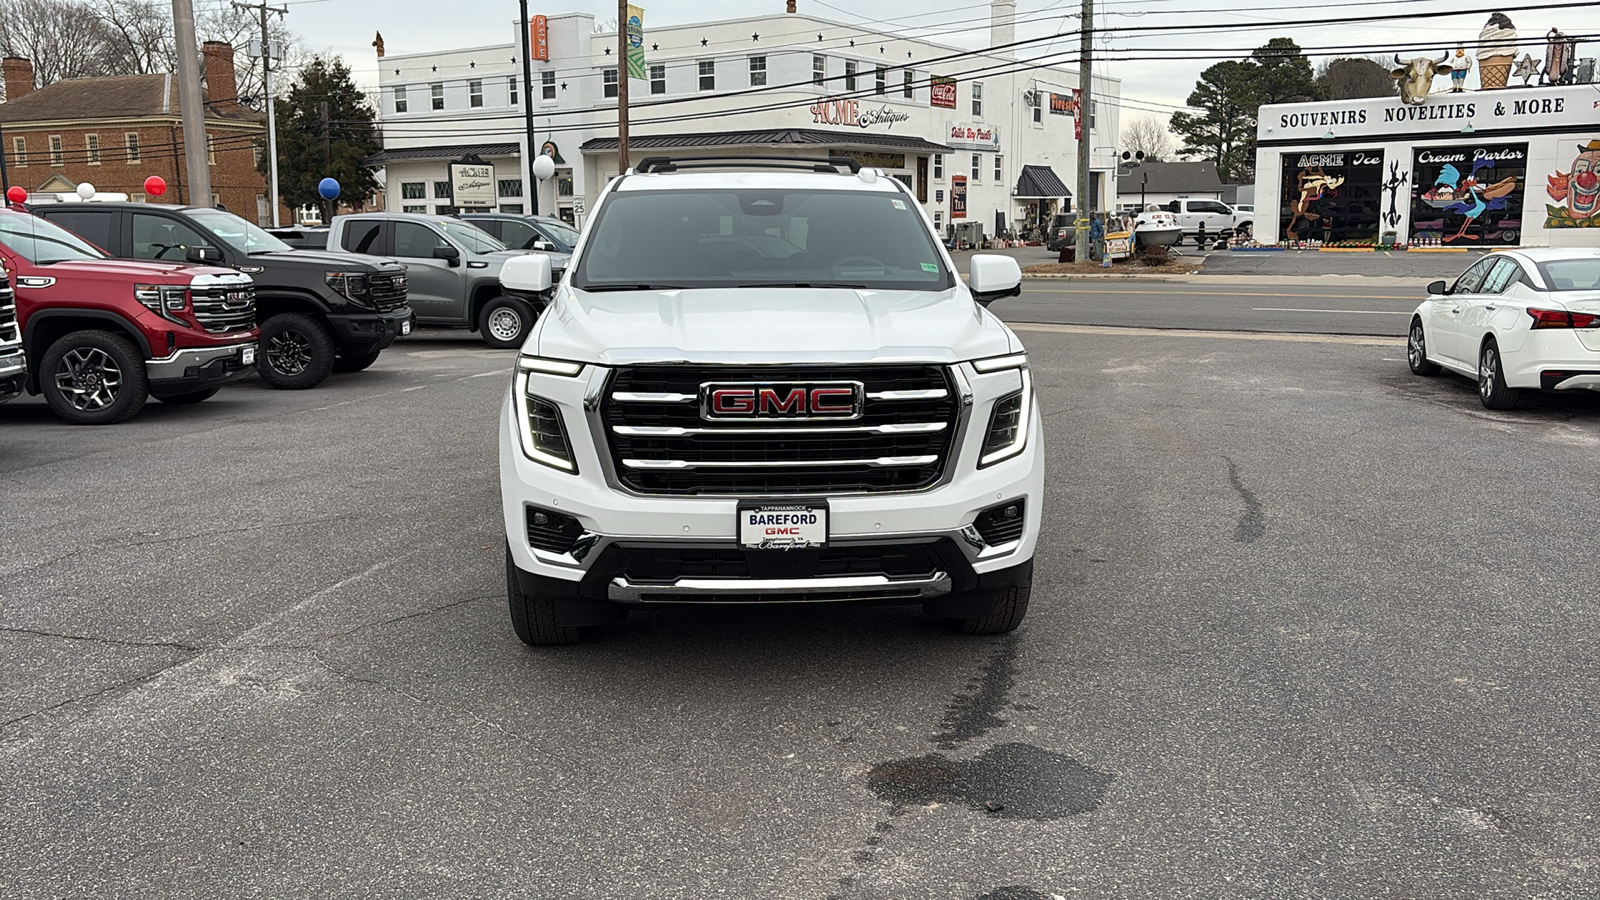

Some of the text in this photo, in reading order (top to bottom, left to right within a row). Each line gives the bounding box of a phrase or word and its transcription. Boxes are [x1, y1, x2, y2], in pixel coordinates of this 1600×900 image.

[538, 19, 546, 57] ACME
[810, 97, 859, 127] ACME
[1280, 98, 1565, 128] SOUVENIRS NOVELTIES & MORE
[966, 127, 976, 142] Boy
[1297, 148, 1525, 167] ACME Ice Cream Parlor
[574, 205, 585, 213] 25
[712, 388, 852, 414] GMC
[749, 514, 817, 525] BAREFORD
[765, 527, 800, 535] GMC
[758, 540, 810, 552] Bareford
